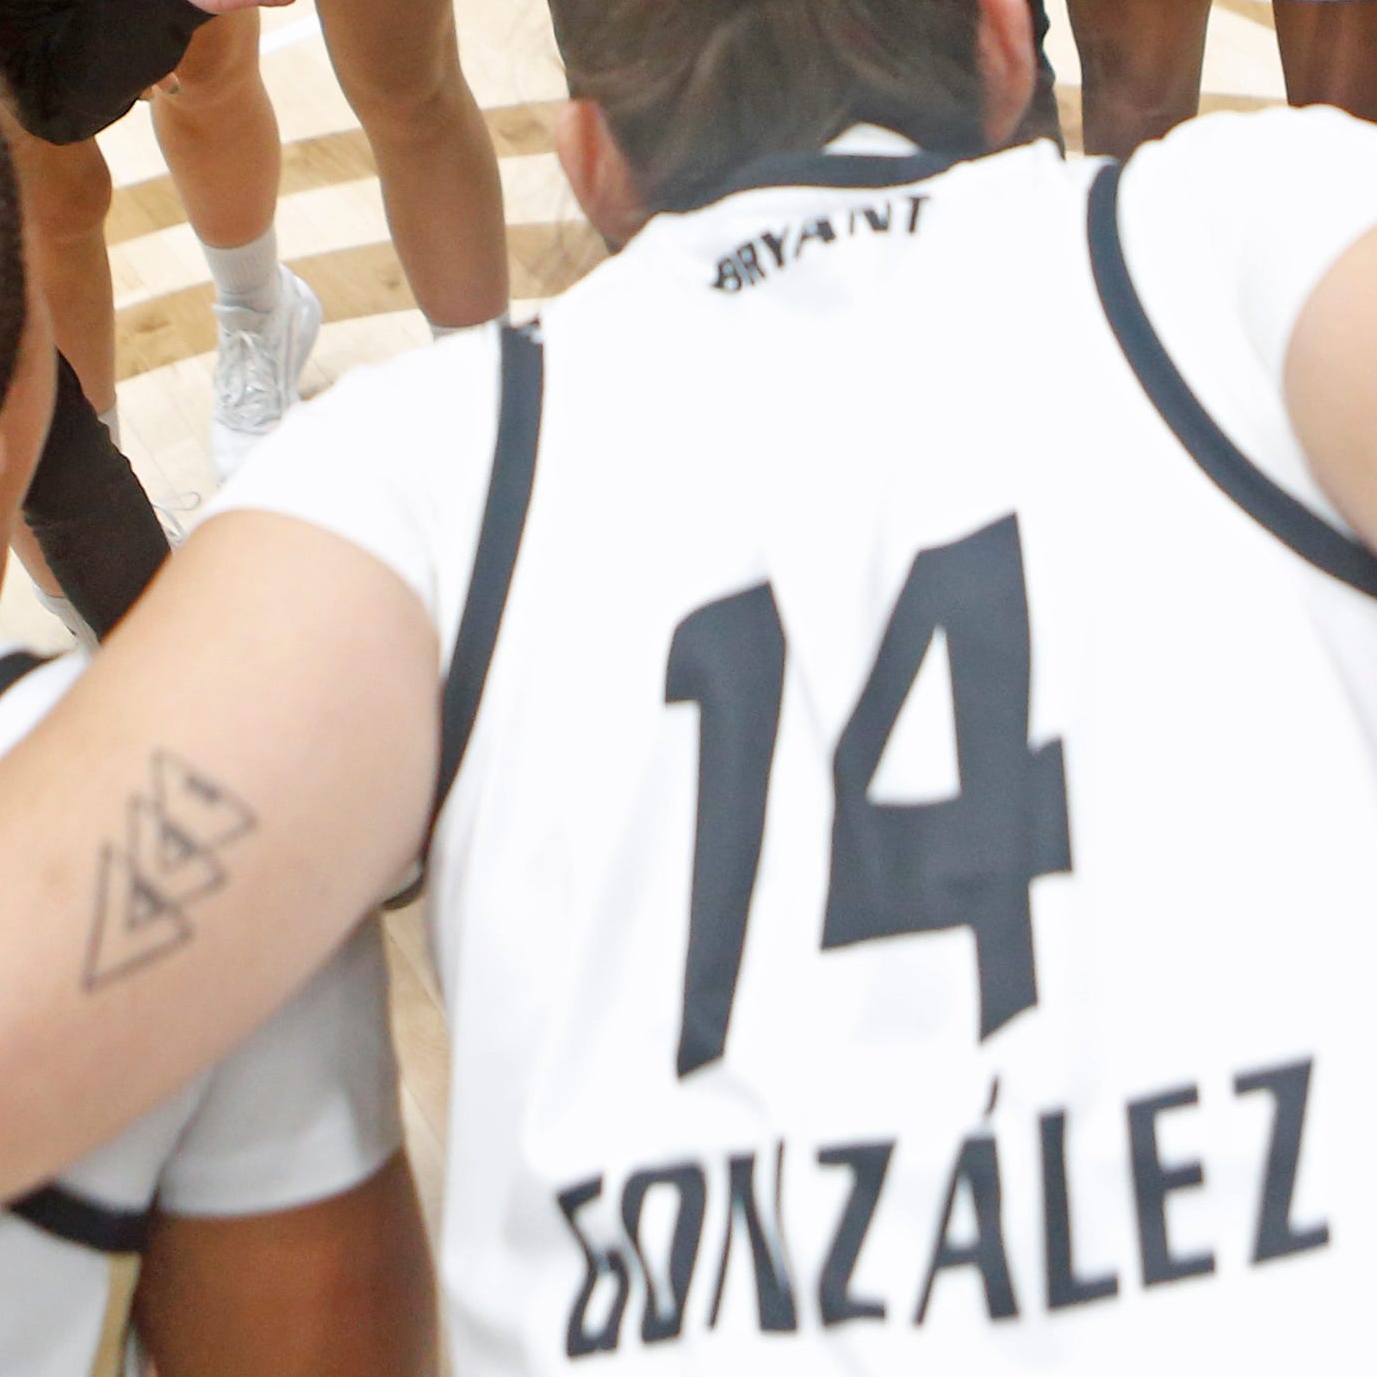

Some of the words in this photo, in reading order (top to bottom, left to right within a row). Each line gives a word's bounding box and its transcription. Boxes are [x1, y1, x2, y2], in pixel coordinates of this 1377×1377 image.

[714, 196, 930, 291] BRYANT
[664, 511, 1073, 1081] 14
[557, 1055, 1331, 1360] GONZÁLEZ
